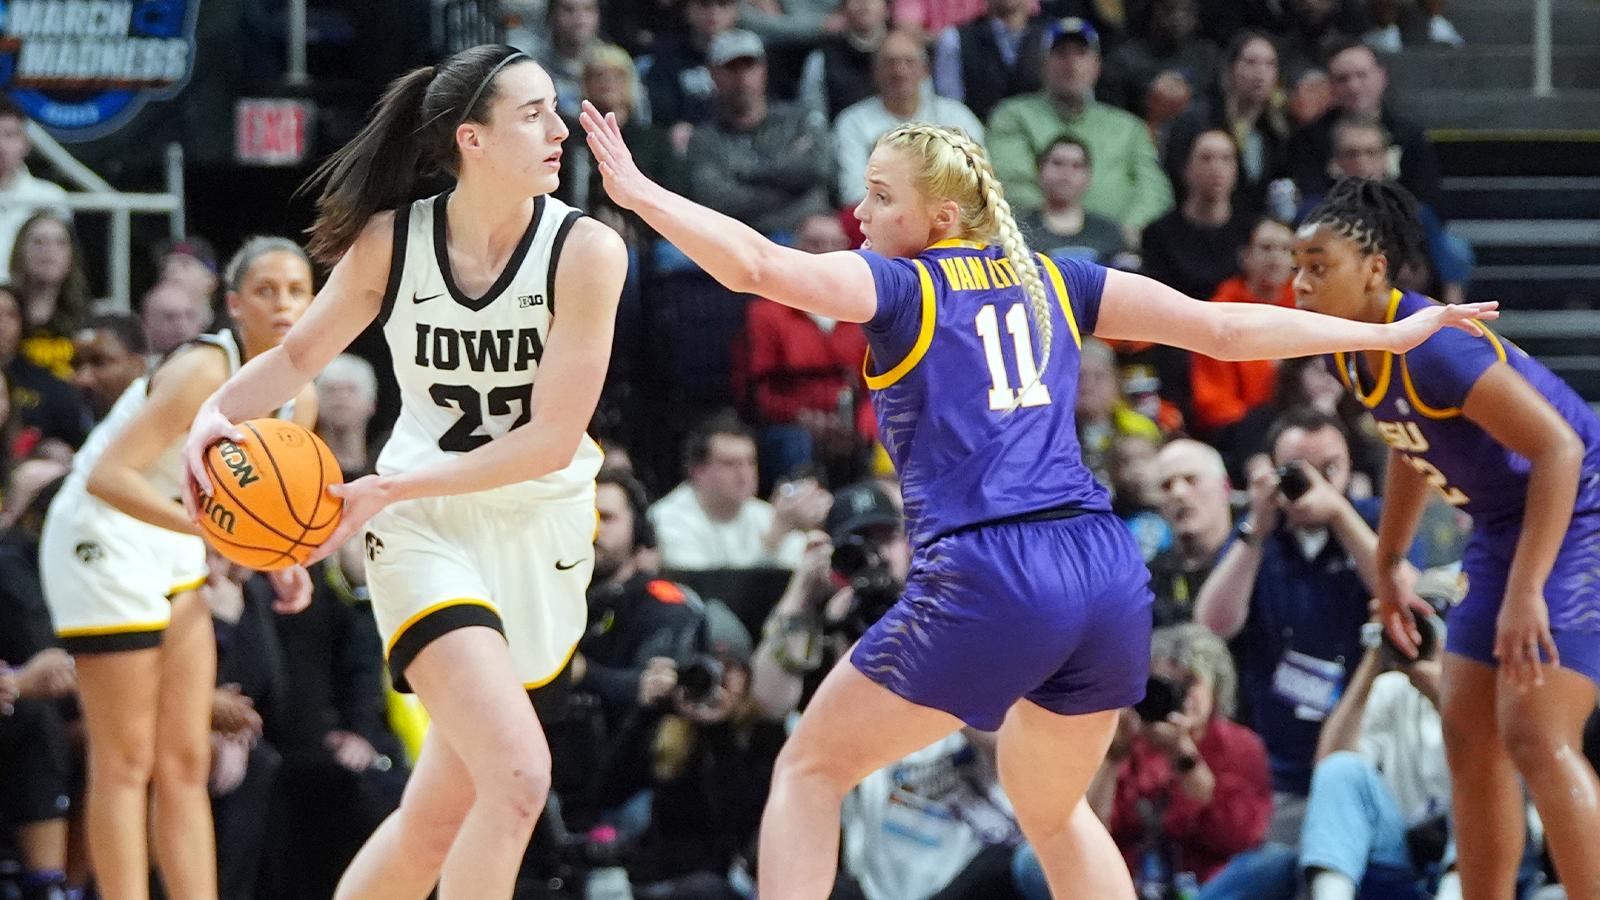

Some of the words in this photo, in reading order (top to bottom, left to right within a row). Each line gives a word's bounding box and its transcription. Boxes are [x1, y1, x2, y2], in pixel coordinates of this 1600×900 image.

[8, 0, 133, 36] MARCH
[18, 38, 190, 80] MADNESS
[240, 105, 305, 157] EXIT
[938, 256, 990, 291] VAN
[985, 257, 1022, 289] LIT
[415, 322, 544, 373] IOWA
[975, 303, 1052, 411] 11
[216, 440, 260, 488] NCA
